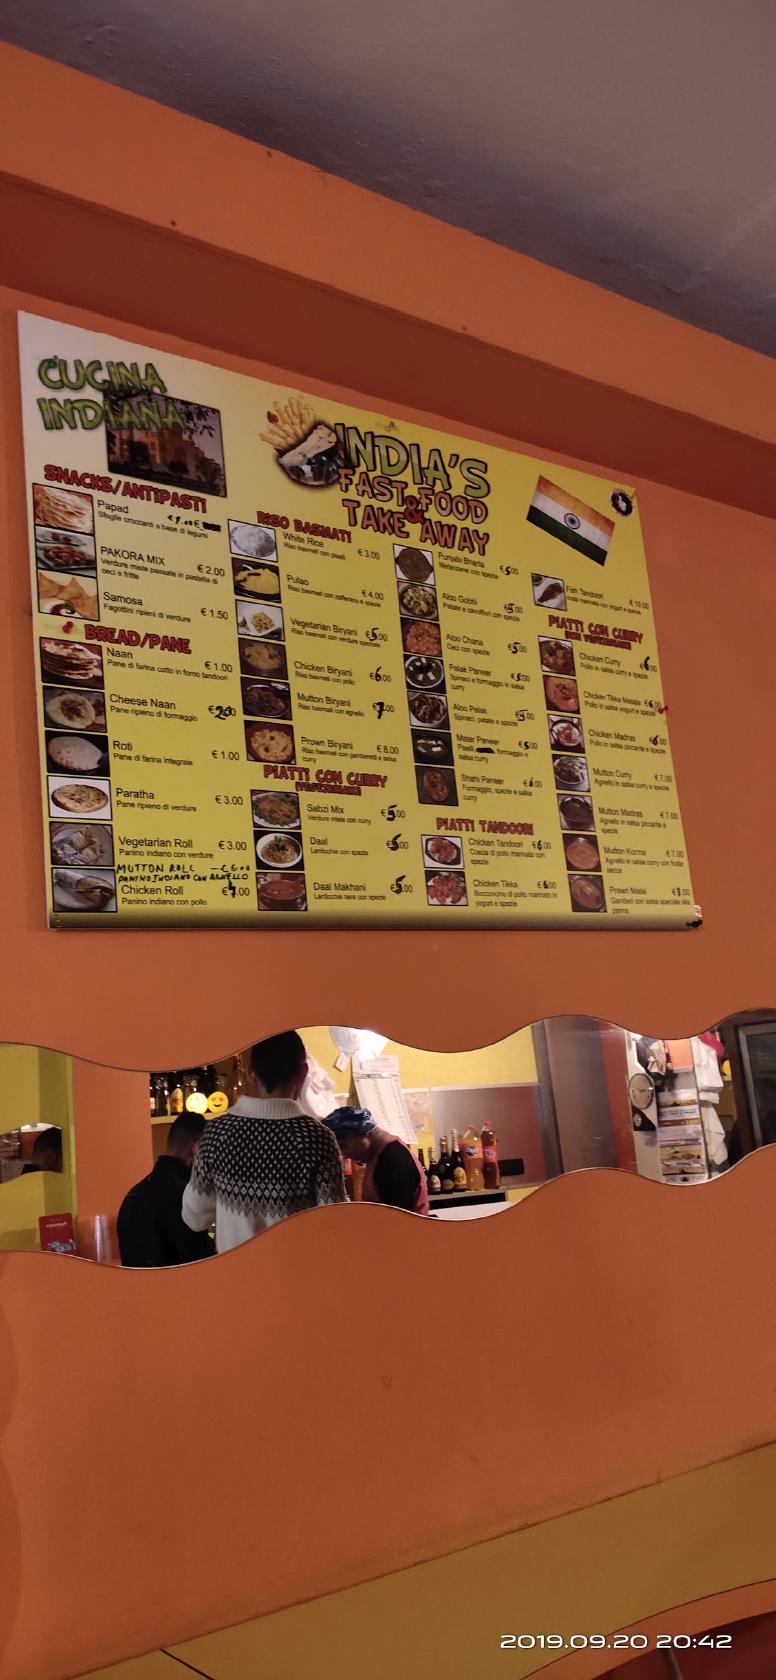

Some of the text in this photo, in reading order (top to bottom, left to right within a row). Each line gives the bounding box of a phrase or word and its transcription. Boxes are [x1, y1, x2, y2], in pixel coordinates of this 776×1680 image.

[38, 356, 167, 393] CUCINA
[37, 397, 187, 430] INDIANA
[334, 423, 490, 498] INDIA'S
[44, 464, 207, 513] SNACKS/ANTIPASTI
[339, 466, 488, 524] FAST FOOD
[97, 499, 129, 514] Papad
[404, 495, 426, 525] &
[98, 510, 122, 522] Sfoglie
[123, 516, 154, 528] croccanti
[187, 529, 208, 539] legumi
[257, 511, 352, 543] RISO BASMATI
[342, 499, 490, 556] TAKE AWAY
[282, 531, 324, 548] White Rice
[100, 546, 165, 566] PAKORA MIX
[101, 558, 128, 568] Verdure
[130, 563, 148, 572] miste
[150, 567, 176, 578] passate
[205, 565, 225, 577] 2.00
[287, 574, 309, 586] Pulao
[103, 592, 143, 606] Samosa
[103, 603, 134, 614] Fagottini
[165, 613, 191, 623] verdure
[209, 609, 229, 620] 1.50
[290, 617, 357, 637] Vegetarian Biryani
[548, 614, 584, 632] PIATTI
[588, 623, 609, 637] CON
[84, 624, 192, 655] BREAD/PANE
[107, 647, 133, 659] Naan
[107, 659, 126, 668] Pane
[135, 663, 156, 672] farina
[213, 662, 233, 673] 1.00
[294, 660, 352, 678] Chicken Biryani
[109, 693, 176, 710] Cheese Naan
[297, 692, 351, 708] Mutton Biryani
[110, 705, 129, 714] Pane
[130, 709, 155, 718] ripieno
[164, 712, 198, 722] formaggio
[113, 740, 133, 751] Roti
[327, 739, 353, 750] Biryani
[113, 752, 132, 761] Pane
[142, 756, 161, 764] farina
[163, 757, 193, 766] integrale
[221, 751, 240, 760] 1.00
[263, 764, 388, 788] PIATTI CON CURRY
[116, 788, 155, 799] Paratha
[224, 796, 243, 805] 3.00
[116, 800, 135, 808] Pane
[137, 802, 161, 810] ripieno
[171, 804, 197, 812] verdure
[306, 803, 345, 814] Sabzi Mix
[436, 817, 475, 832] PIATTI
[118, 837, 193, 848] Vegetarian Roll
[227, 841, 247, 851] 3.00
[310, 837, 328, 846] Daal
[468, 838, 495, 847] Chicken
[117, 863, 196, 874] MUTTON ROLL
[118, 875, 151, 883] PANINO
[473, 879, 499, 888] Chicken
[121, 884, 184, 895] Chicken Roll
[313, 882, 366, 891] Daal Makhani
[121, 897, 147, 905] Panino
[191, 898, 207, 906] pollo
